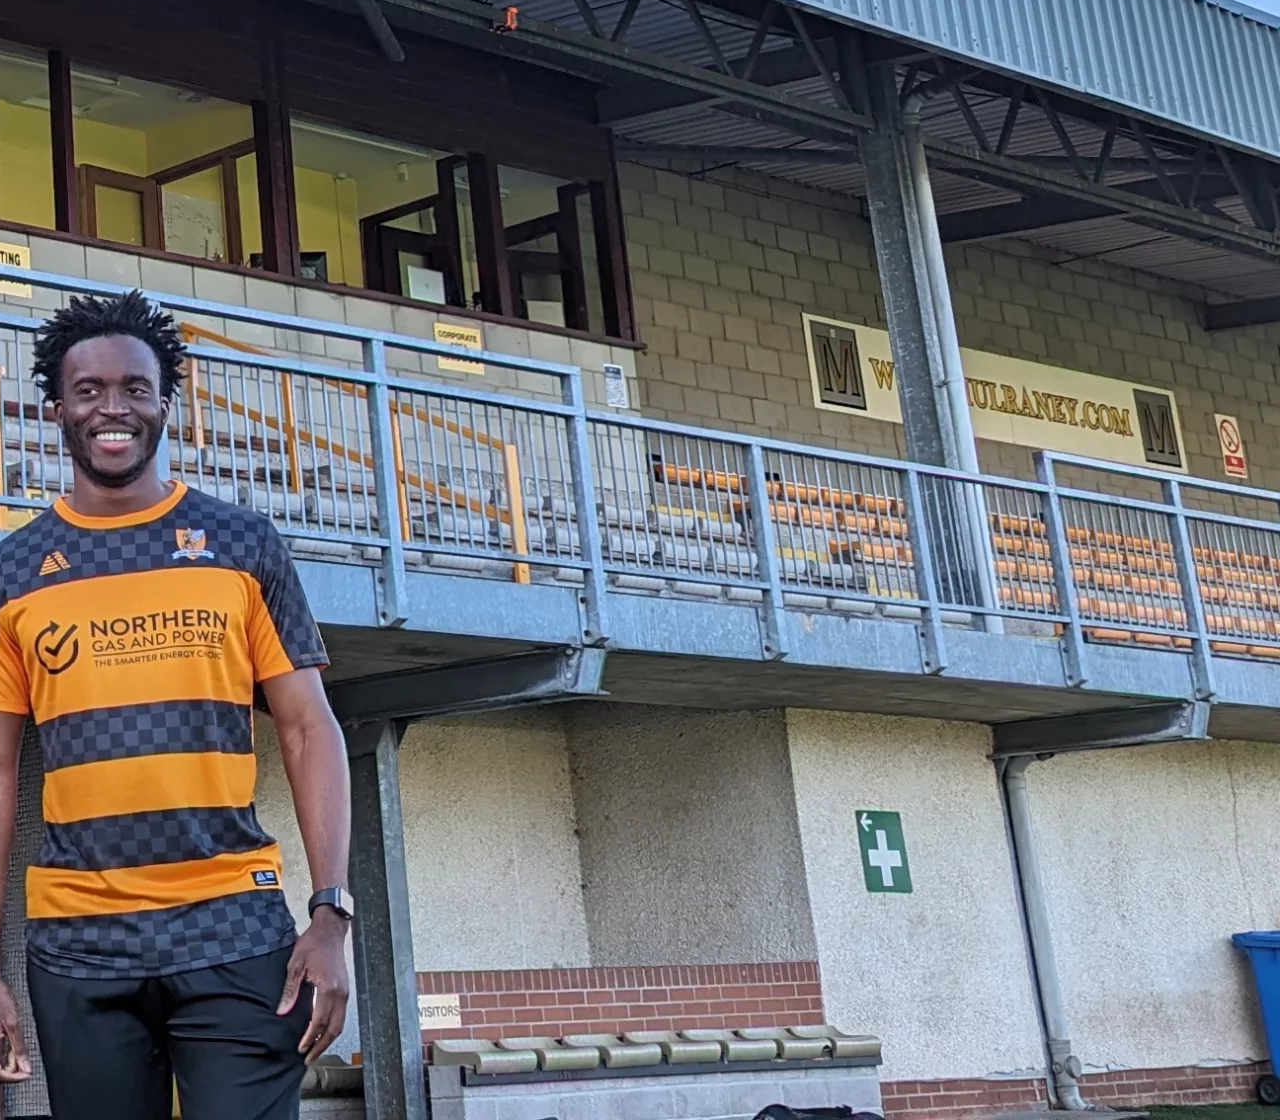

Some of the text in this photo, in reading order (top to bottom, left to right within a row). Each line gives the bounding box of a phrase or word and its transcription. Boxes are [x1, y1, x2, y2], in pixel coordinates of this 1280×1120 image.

[90, 608, 228, 638] NORTHERN
[91, 629, 225, 653] GAS AND POWER
[93, 658, 112, 668] THE
[114, 654, 158, 666] SMARTER
[160, 650, 195, 661] ENERGY
